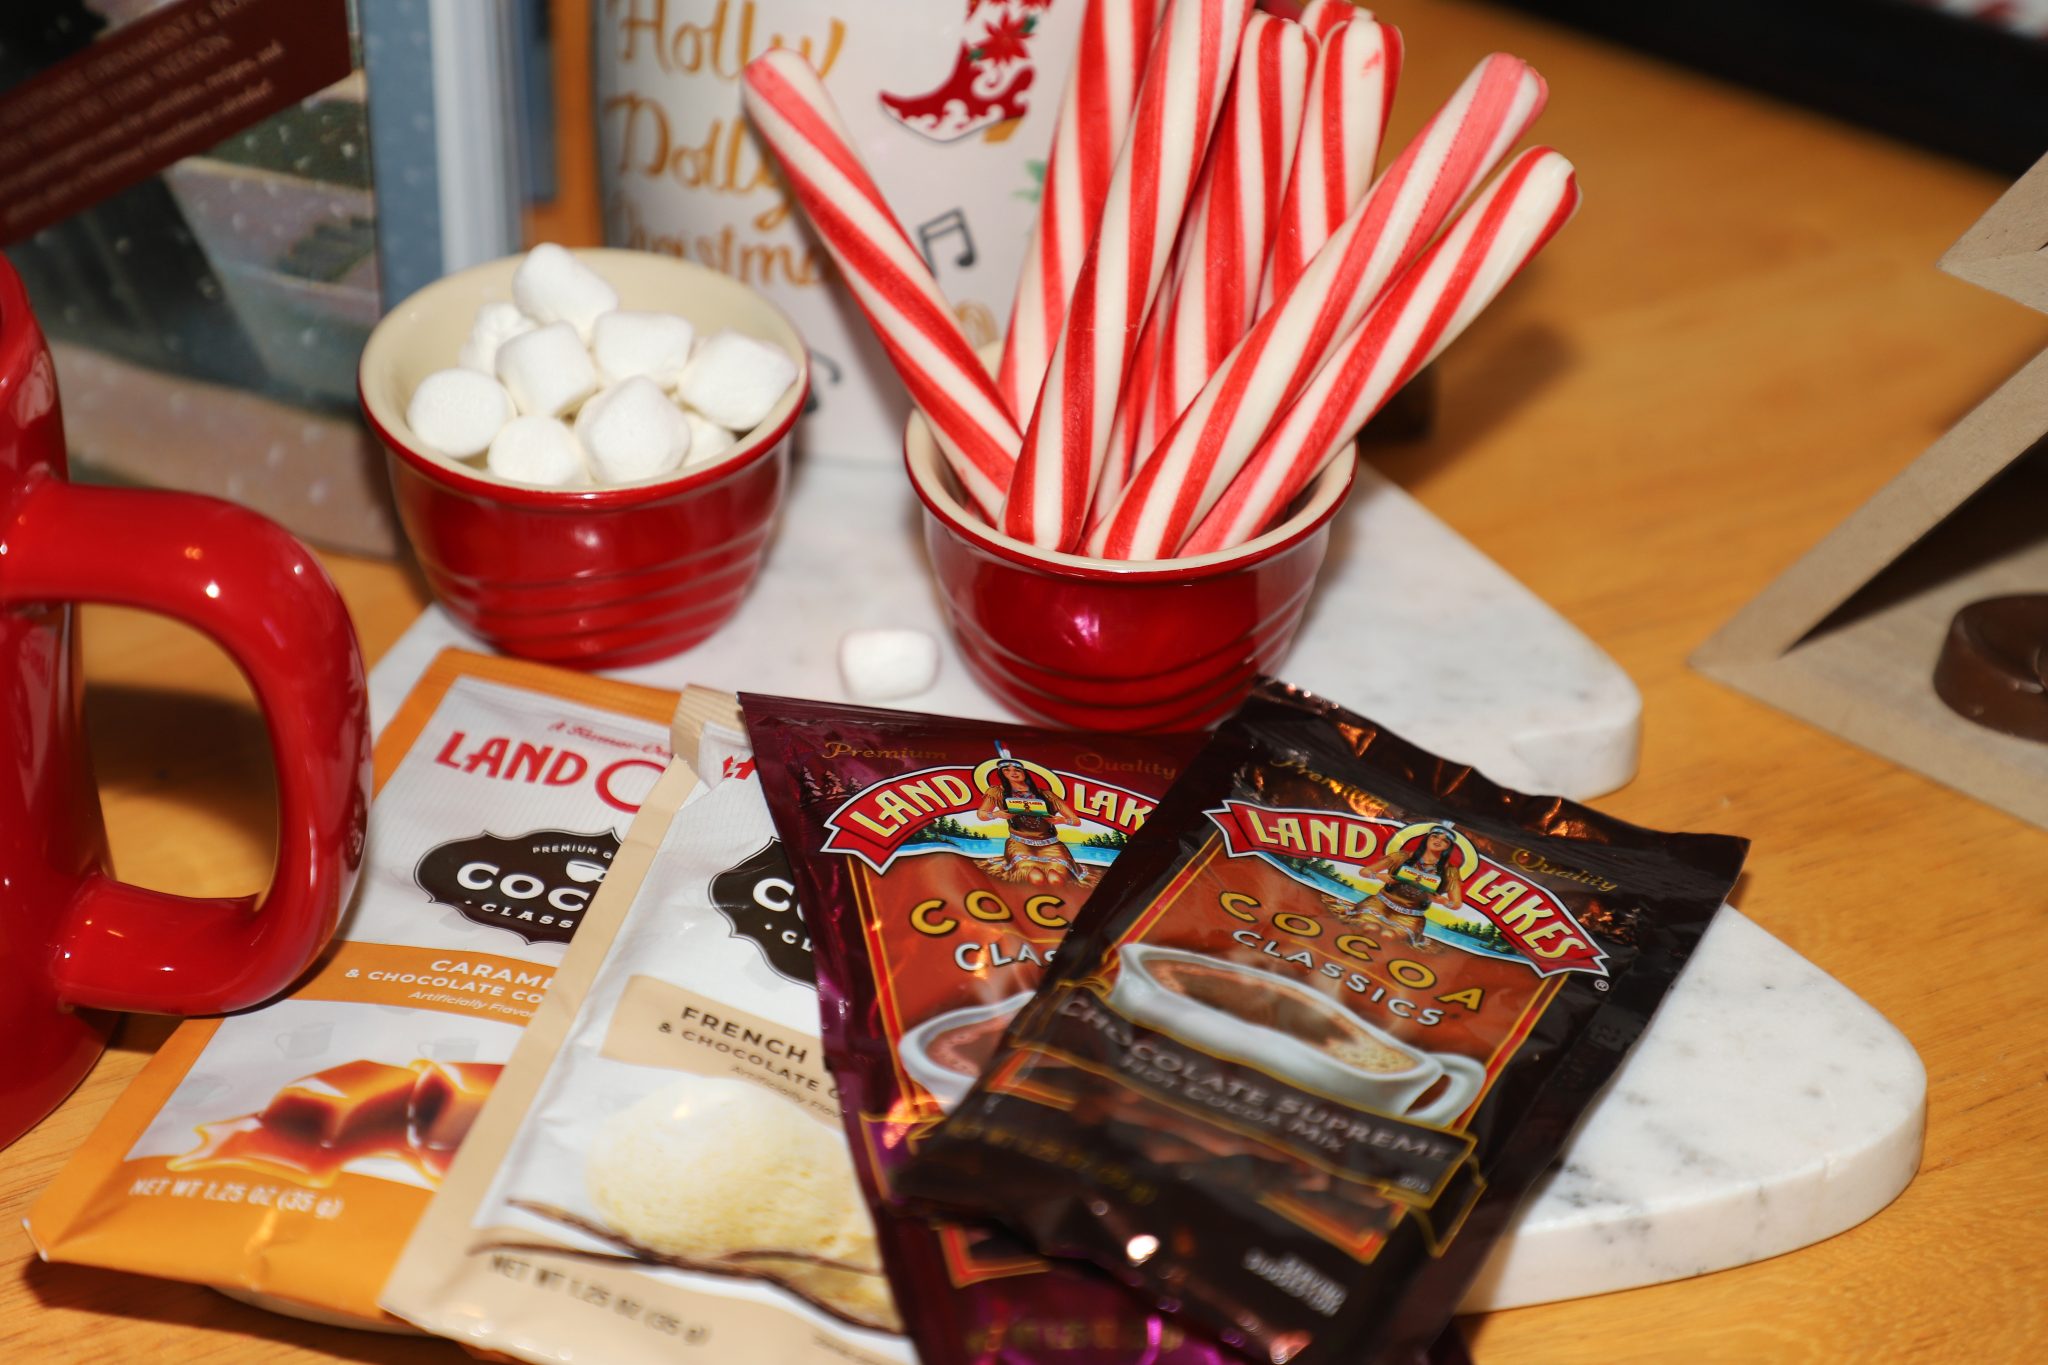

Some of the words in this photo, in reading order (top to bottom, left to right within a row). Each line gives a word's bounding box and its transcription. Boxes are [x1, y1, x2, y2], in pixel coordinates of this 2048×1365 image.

[434, 731, 589, 787] LAND
[821, 742, 948, 761] Premium
[1074, 753, 1178, 780] Quality
[849, 773, 970, 837] LAND
[532, 842, 597, 855] PREMIUM
[1510, 847, 1618, 892] Quality
[456, 862, 590, 912] COC
[1247, 810, 1377, 860] LAND
[1466, 864, 1587, 959] LAKES
[910, 889, 1069, 938] COC
[1218, 890, 1485, 1012] COCOA
[1231, 929, 1444, 1027] CLASSICS
[344, 968, 360, 979] &
[367, 970, 506, 997] CHOCOLATE
[408, 991, 488, 1010] Artificially
[658, 1021, 673, 1033] &
[682, 1030, 819, 1092] CHOCOLATE
[681, 1006, 808, 1064] FRENCH
[1059, 999, 1270, 1105] CHOCOLATE
[1273, 1097, 1450, 1162] SUPREME
[1120, 1055, 1177, 1089] HOT
[1184, 1086, 1281, 1128] COCOA
[1287, 1119, 1346, 1153] MIX
[128, 1177, 171, 1196] NET
[171, 1179, 203, 1198] WT
